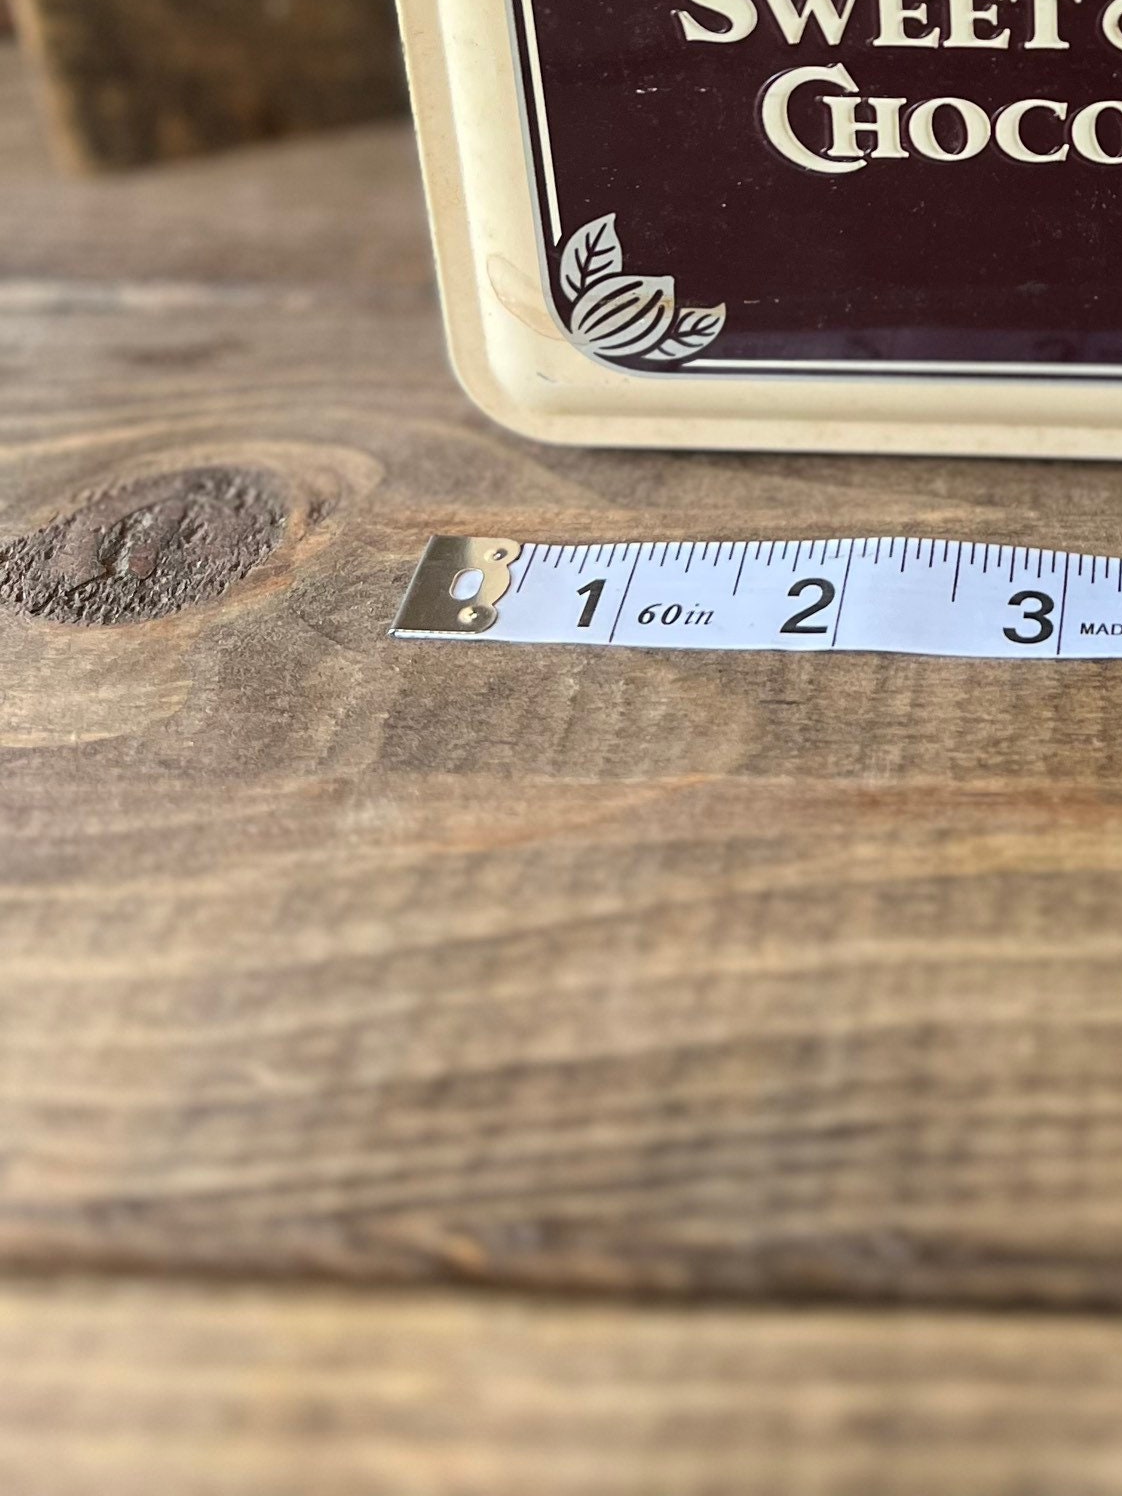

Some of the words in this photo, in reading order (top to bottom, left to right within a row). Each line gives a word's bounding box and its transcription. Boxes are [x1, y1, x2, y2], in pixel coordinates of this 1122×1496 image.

[576, 579, 606, 628] 1
[780, 577, 837, 634] 2
[1002, 590, 1055, 645] 3
